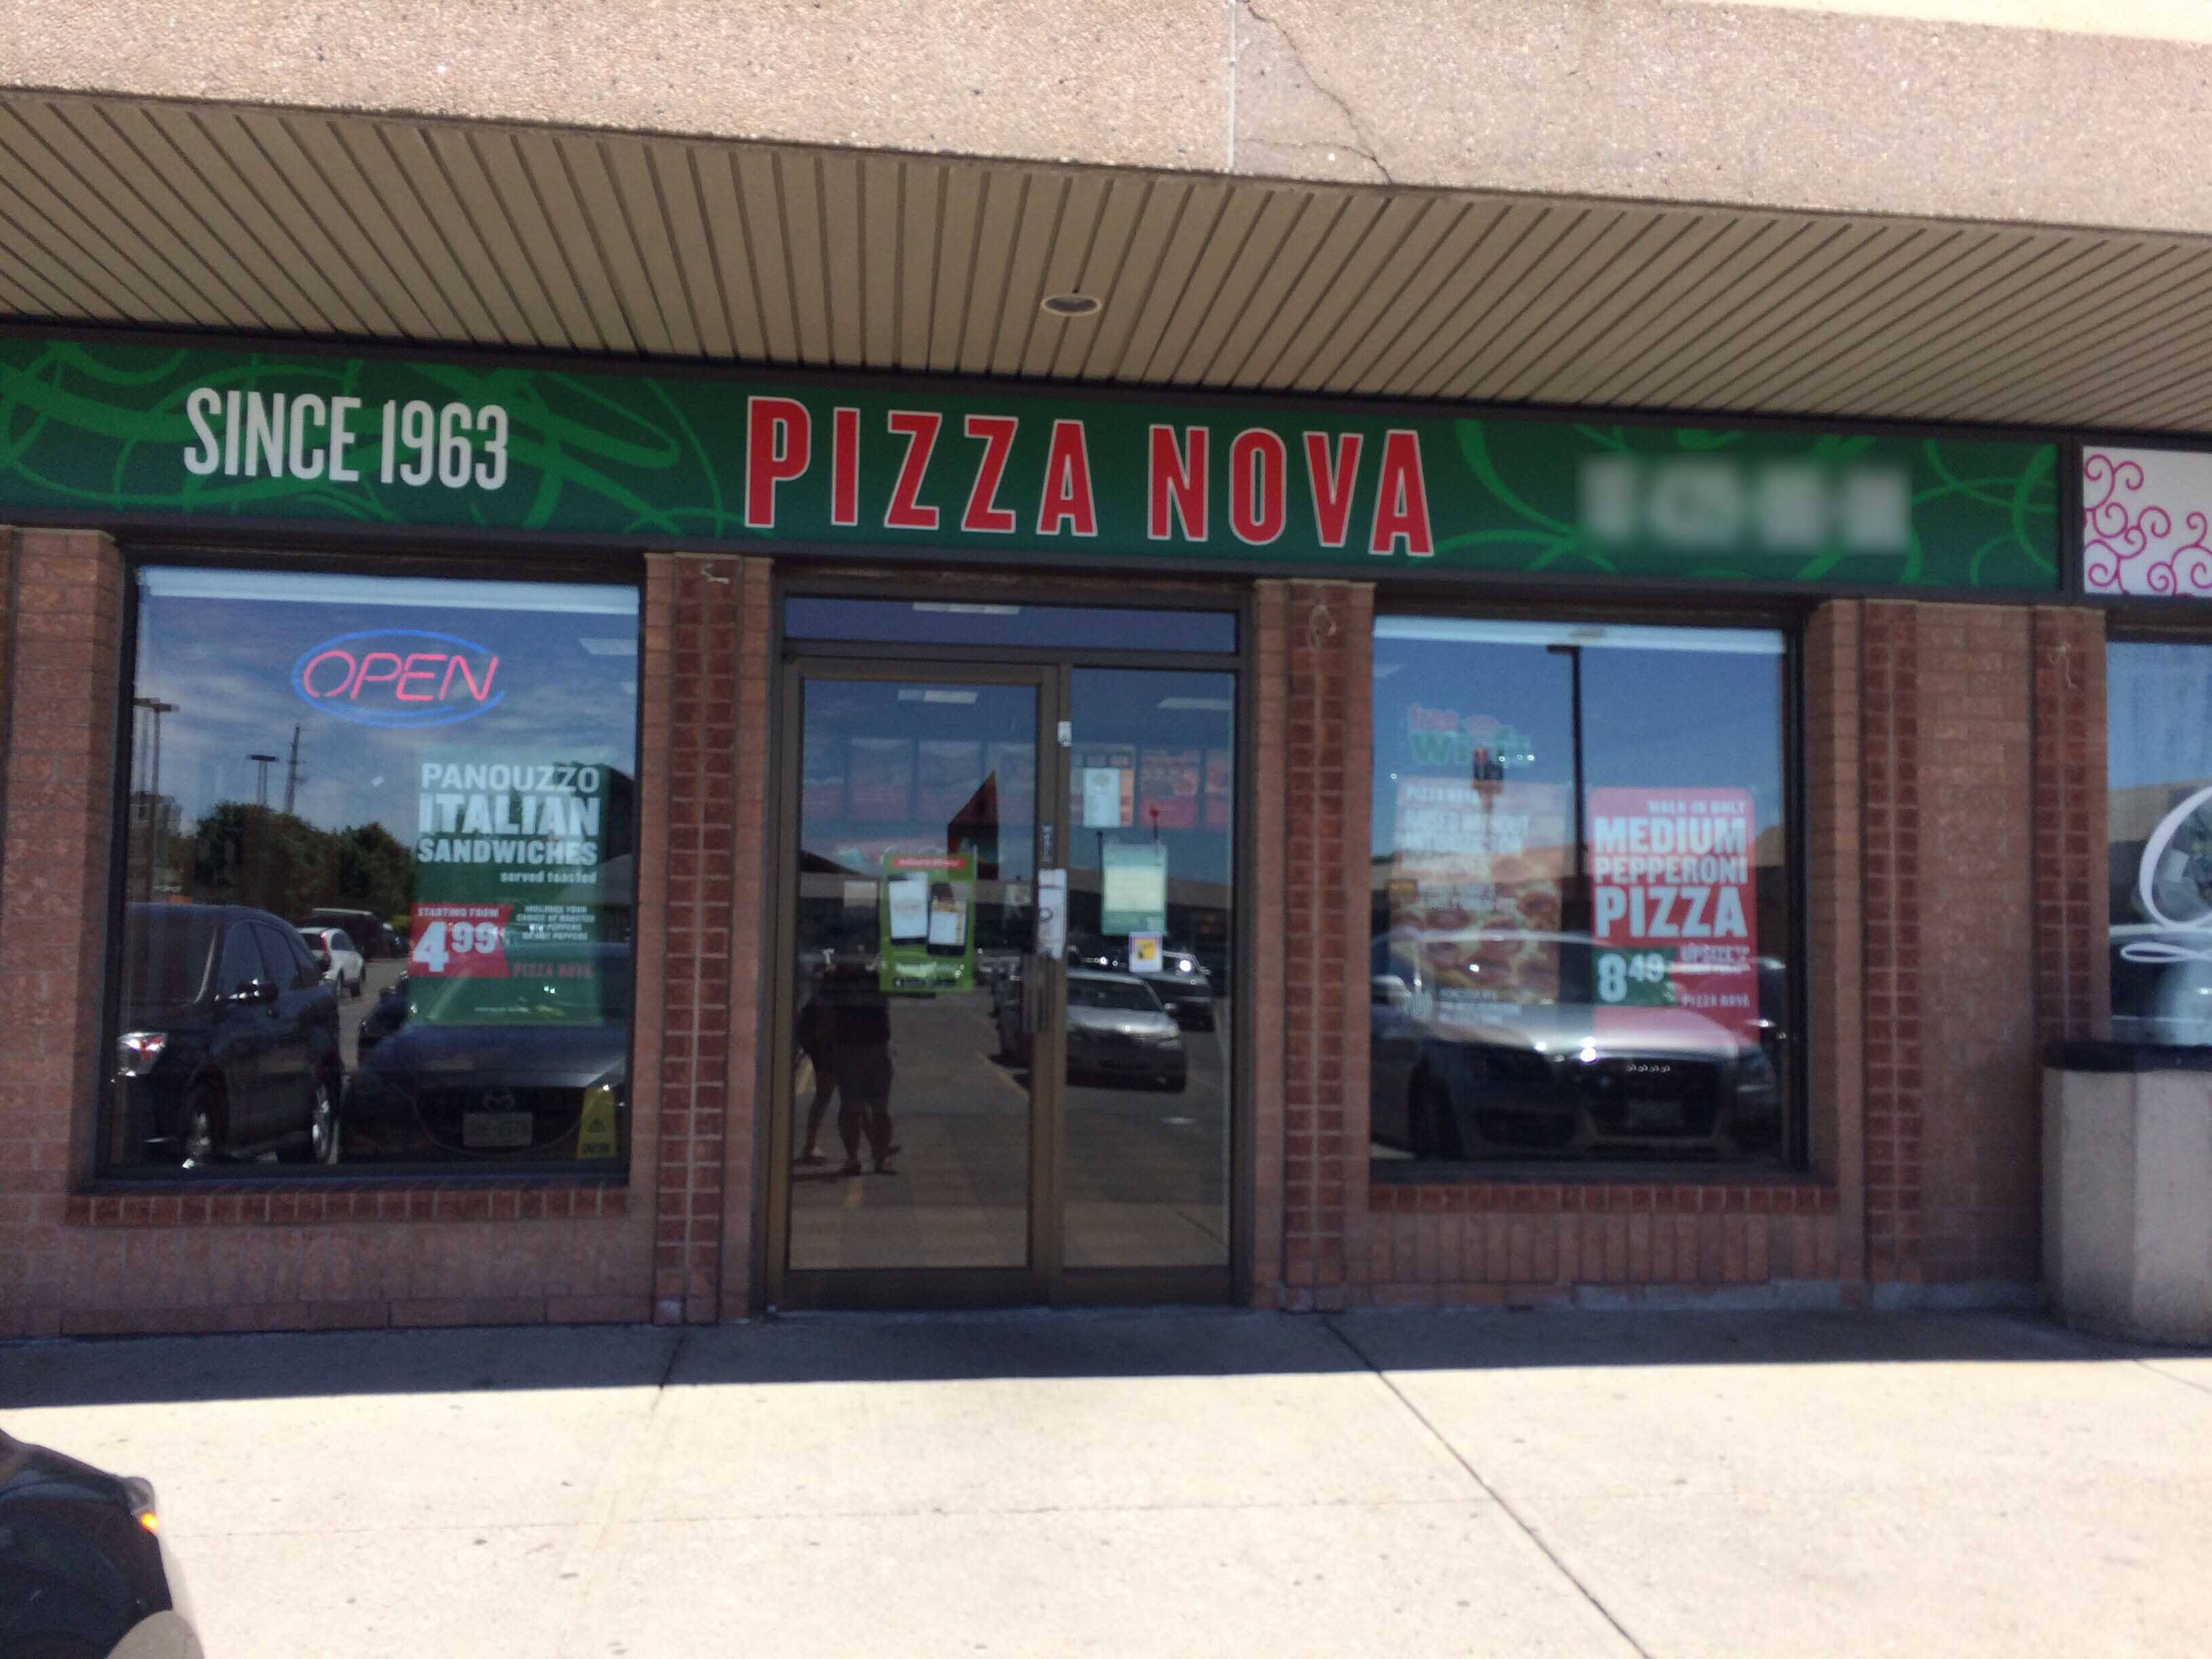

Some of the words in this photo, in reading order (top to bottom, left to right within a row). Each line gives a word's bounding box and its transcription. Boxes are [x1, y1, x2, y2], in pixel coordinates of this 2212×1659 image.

[184, 388, 361, 482] SINCE
[380, 400, 508, 490] 1963
[745, 395, 1098, 537] PIZZA
[1147, 424, 1434, 556] NOVA
[303, 650, 499, 701] OPEN
[422, 763, 600, 793] PANOUZZO
[418, 793, 600, 836] ITALIAN
[1593, 817, 1747, 855] MEDIUM
[417, 838, 598, 865] SANDWICHES
[1593, 855, 1748, 884] PEPPERONI
[1595, 886, 1749, 938] PIZZA
